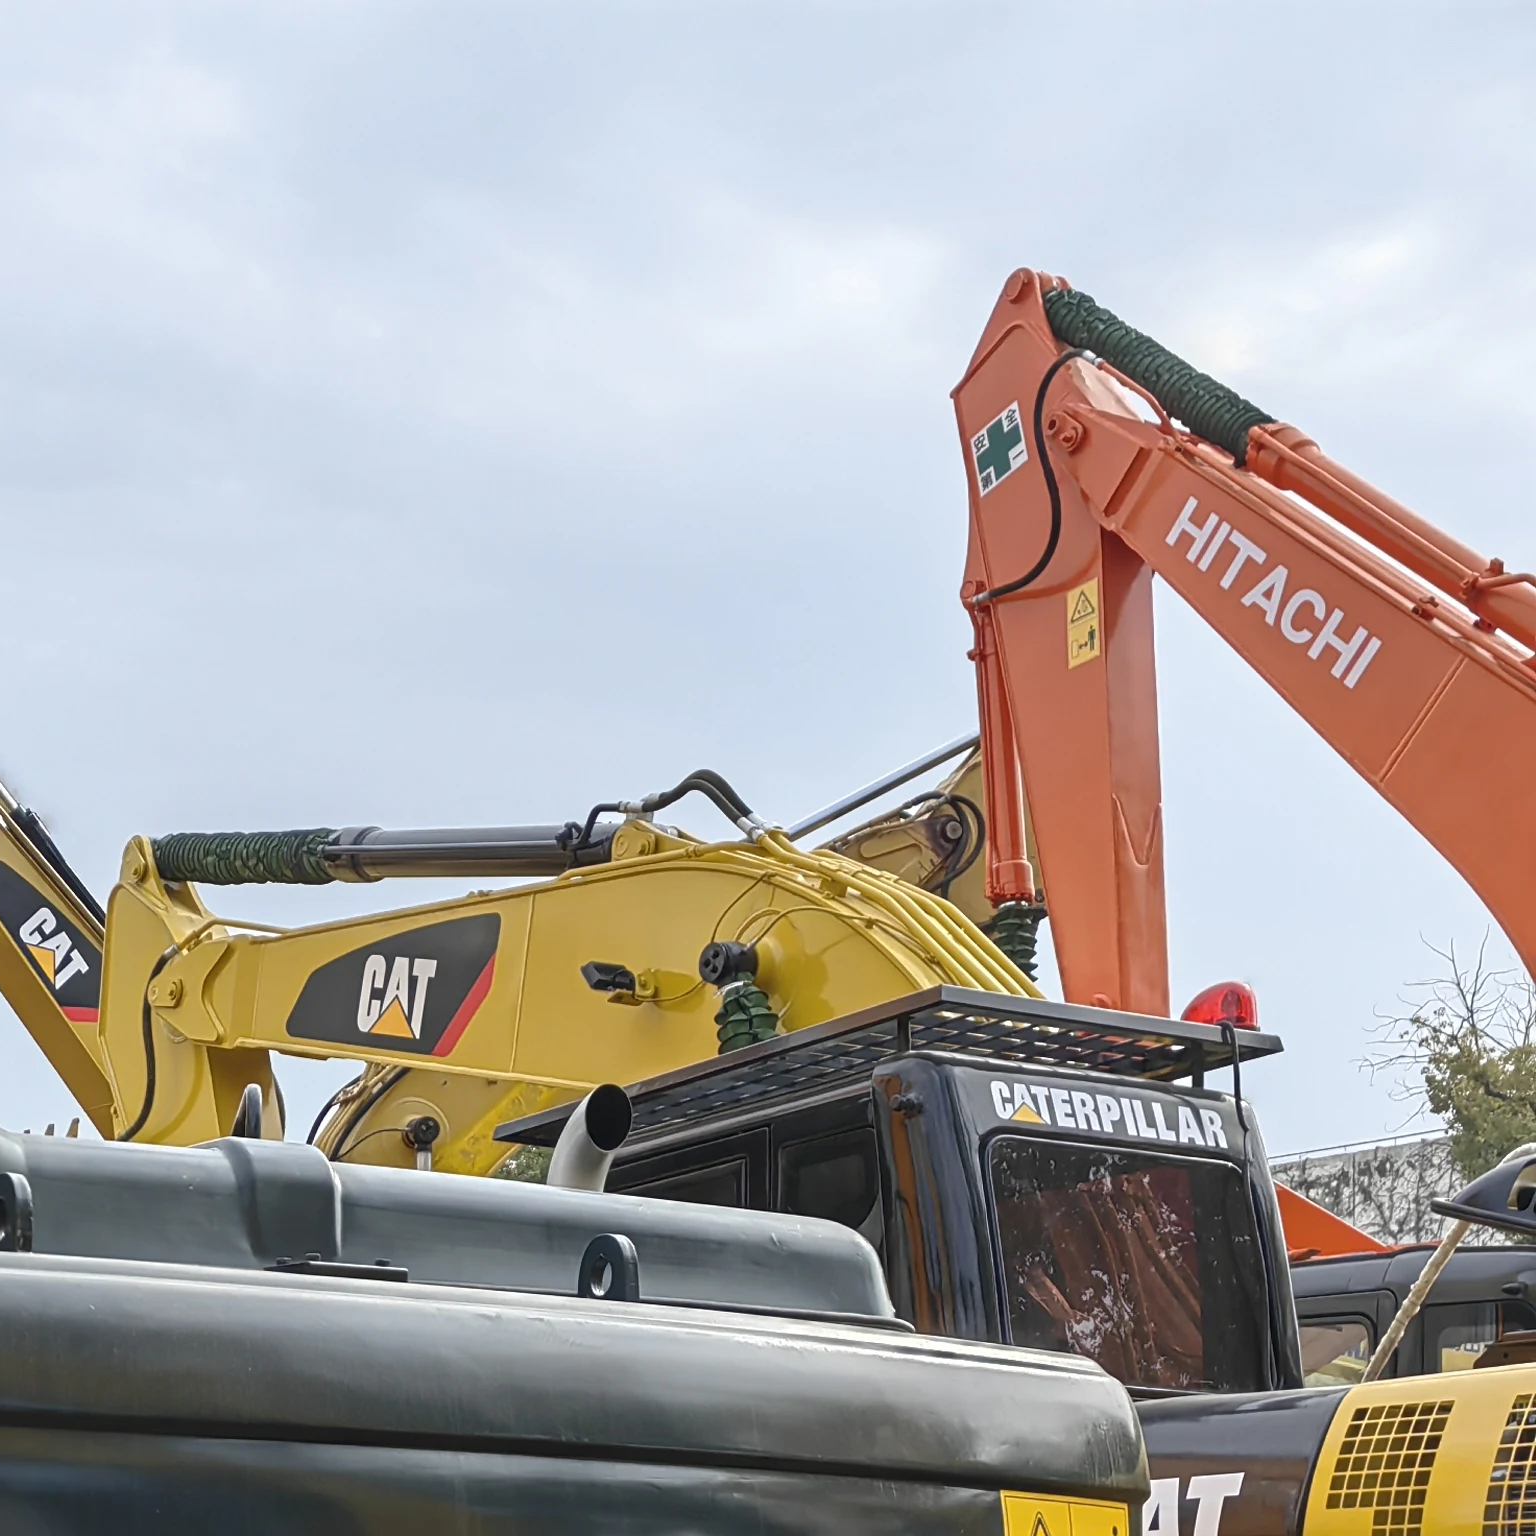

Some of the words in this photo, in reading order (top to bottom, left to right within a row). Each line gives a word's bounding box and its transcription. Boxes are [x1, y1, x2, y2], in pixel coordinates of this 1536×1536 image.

[1165, 495, 1382, 689] HITACHI
[20, 907, 89, 990] CAT
[357, 954, 438, 1040] CAT
[990, 1080, 1228, 1149] CATERPILLAR
